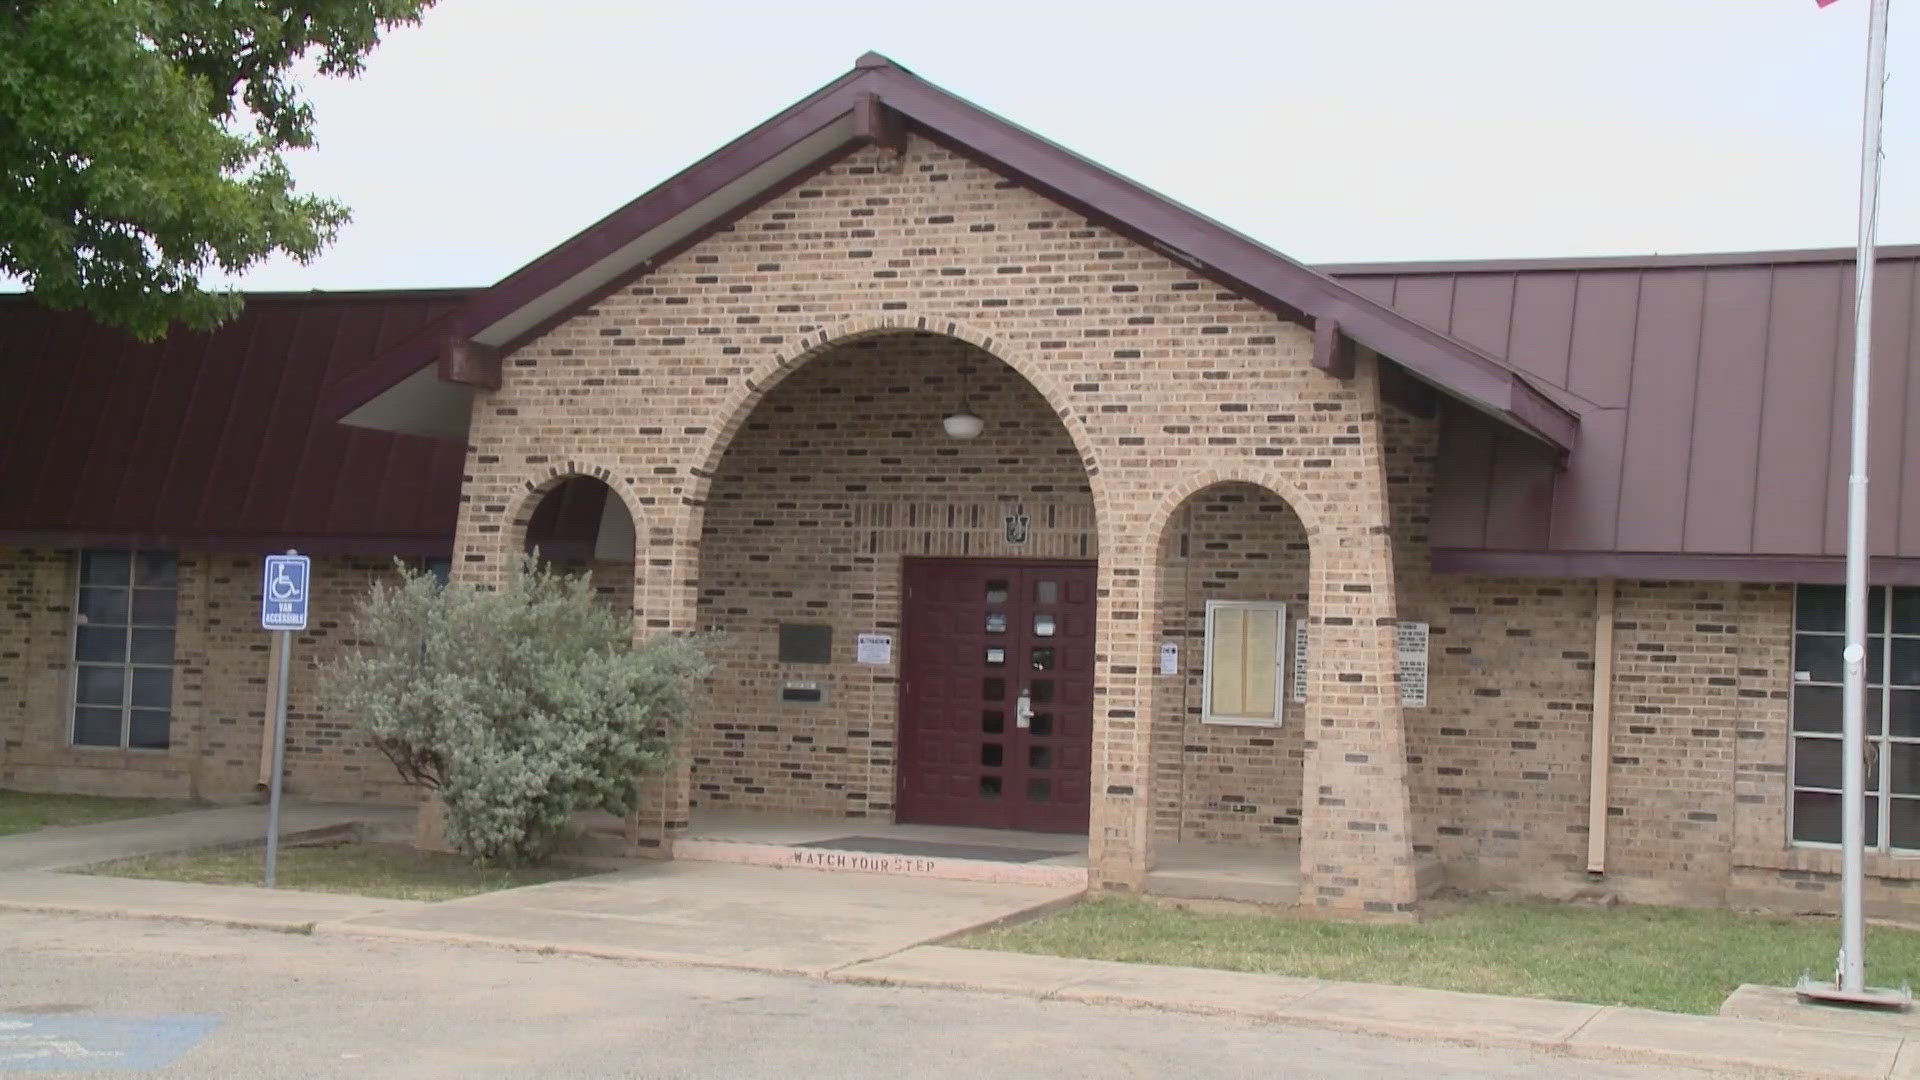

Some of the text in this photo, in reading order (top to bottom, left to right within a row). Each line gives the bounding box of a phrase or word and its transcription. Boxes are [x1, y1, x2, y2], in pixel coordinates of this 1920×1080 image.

[279, 602, 292, 612] VAN
[266, 613, 304, 624] ACCESSIBLE
[794, 851, 935, 872] WATCH YOUR STEP
